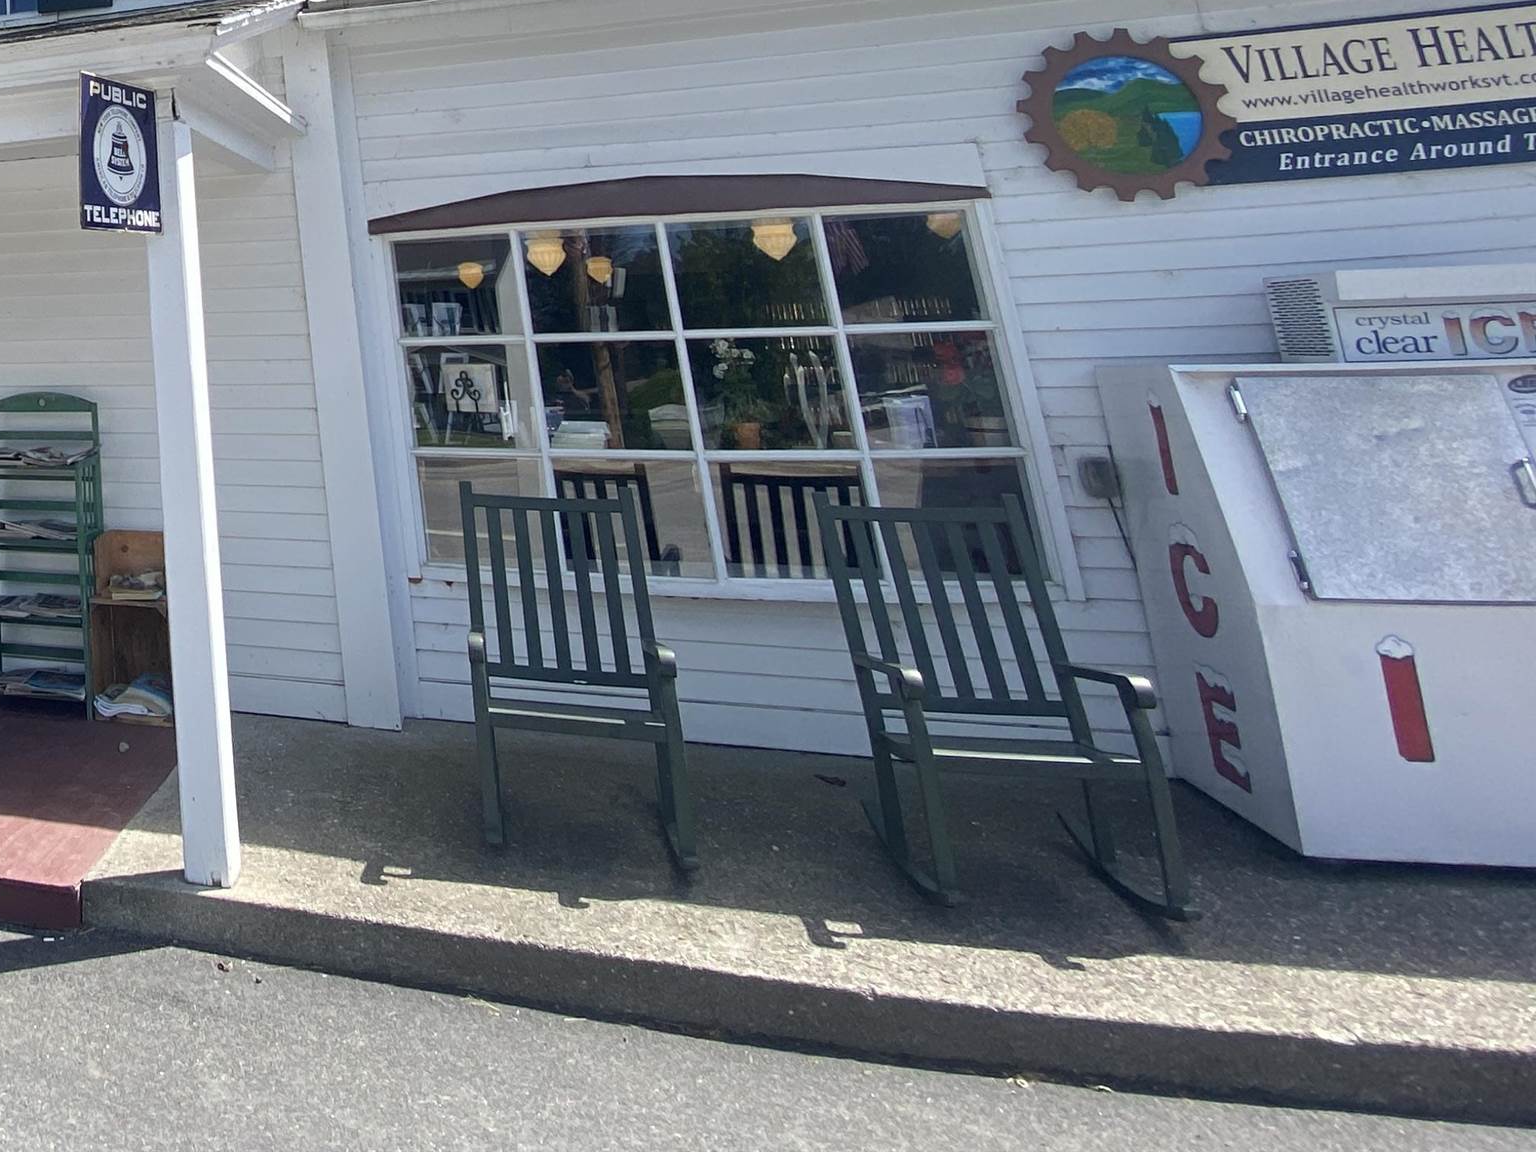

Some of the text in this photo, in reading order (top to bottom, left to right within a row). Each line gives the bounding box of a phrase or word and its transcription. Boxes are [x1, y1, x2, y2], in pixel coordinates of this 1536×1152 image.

[1220, 37, 1398, 84] VILLAGE
[89, 80, 147, 109] PUBLIC
[1279, 147, 1399, 171] Entrance
[1409, 134, 1511, 161] Around
[83, 204, 161, 228] TELEPHONE
[1355, 311, 1431, 330] crystal
[1355, 330, 1439, 355] clear
